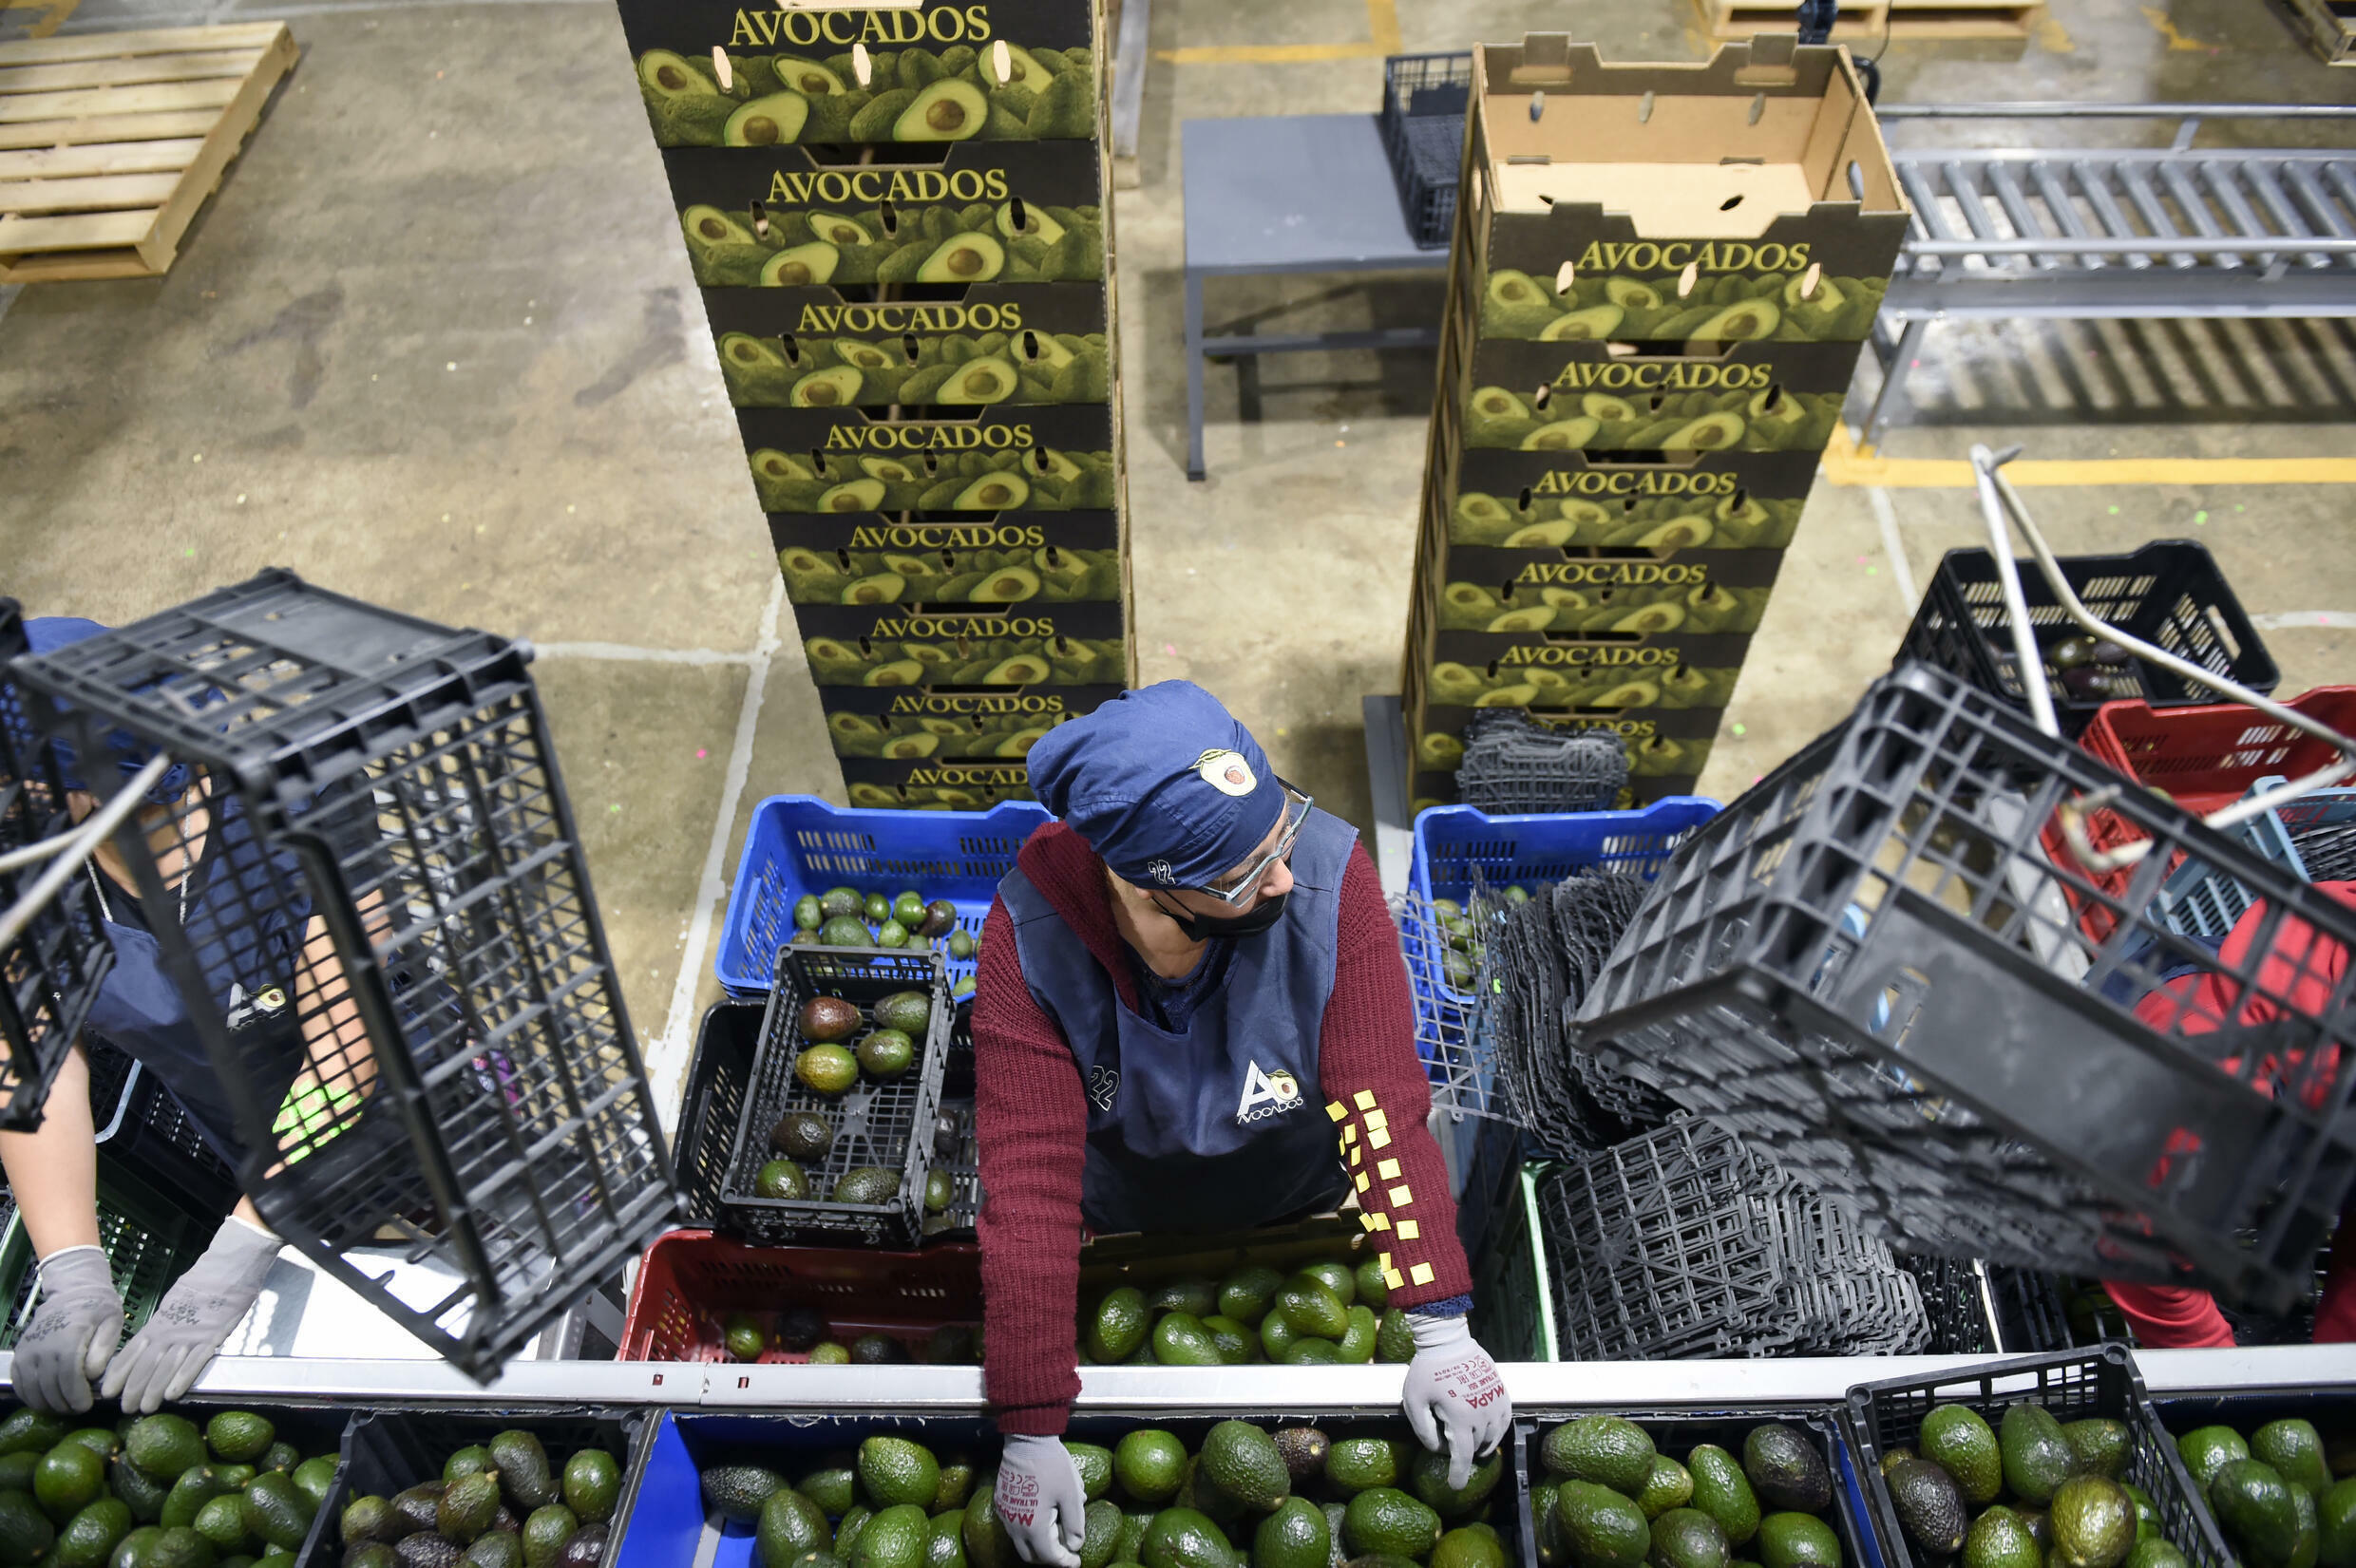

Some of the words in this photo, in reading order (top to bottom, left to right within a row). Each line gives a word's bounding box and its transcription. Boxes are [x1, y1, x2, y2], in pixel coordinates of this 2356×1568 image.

[729, 6, 992, 47] AVOCADOS
[766, 169, 1008, 203] AVOCADOS
[1572, 239, 1812, 273] AVOCADOS
[796, 303, 1022, 333] AVOCADOS
[1552, 360, 1773, 389] AVOCADOS
[825, 424, 1034, 450] AVOCADOS
[1531, 470, 1738, 496] AVOCADOS
[848, 524, 1045, 548] AVOCADOS
[1515, 562, 1707, 585] AVOCADOS
[871, 617, 1054, 638] AVOCADOS
[1499, 644, 1680, 667] AVOCADOS
[889, 695, 1064, 714] AVOCADOS
[906, 766, 1028, 785] AVOCAD
[1147, 859, 1176, 885] 22
[1089, 1065, 1119, 1112] 22
[1465, 1383, 1506, 1409] MAPA
